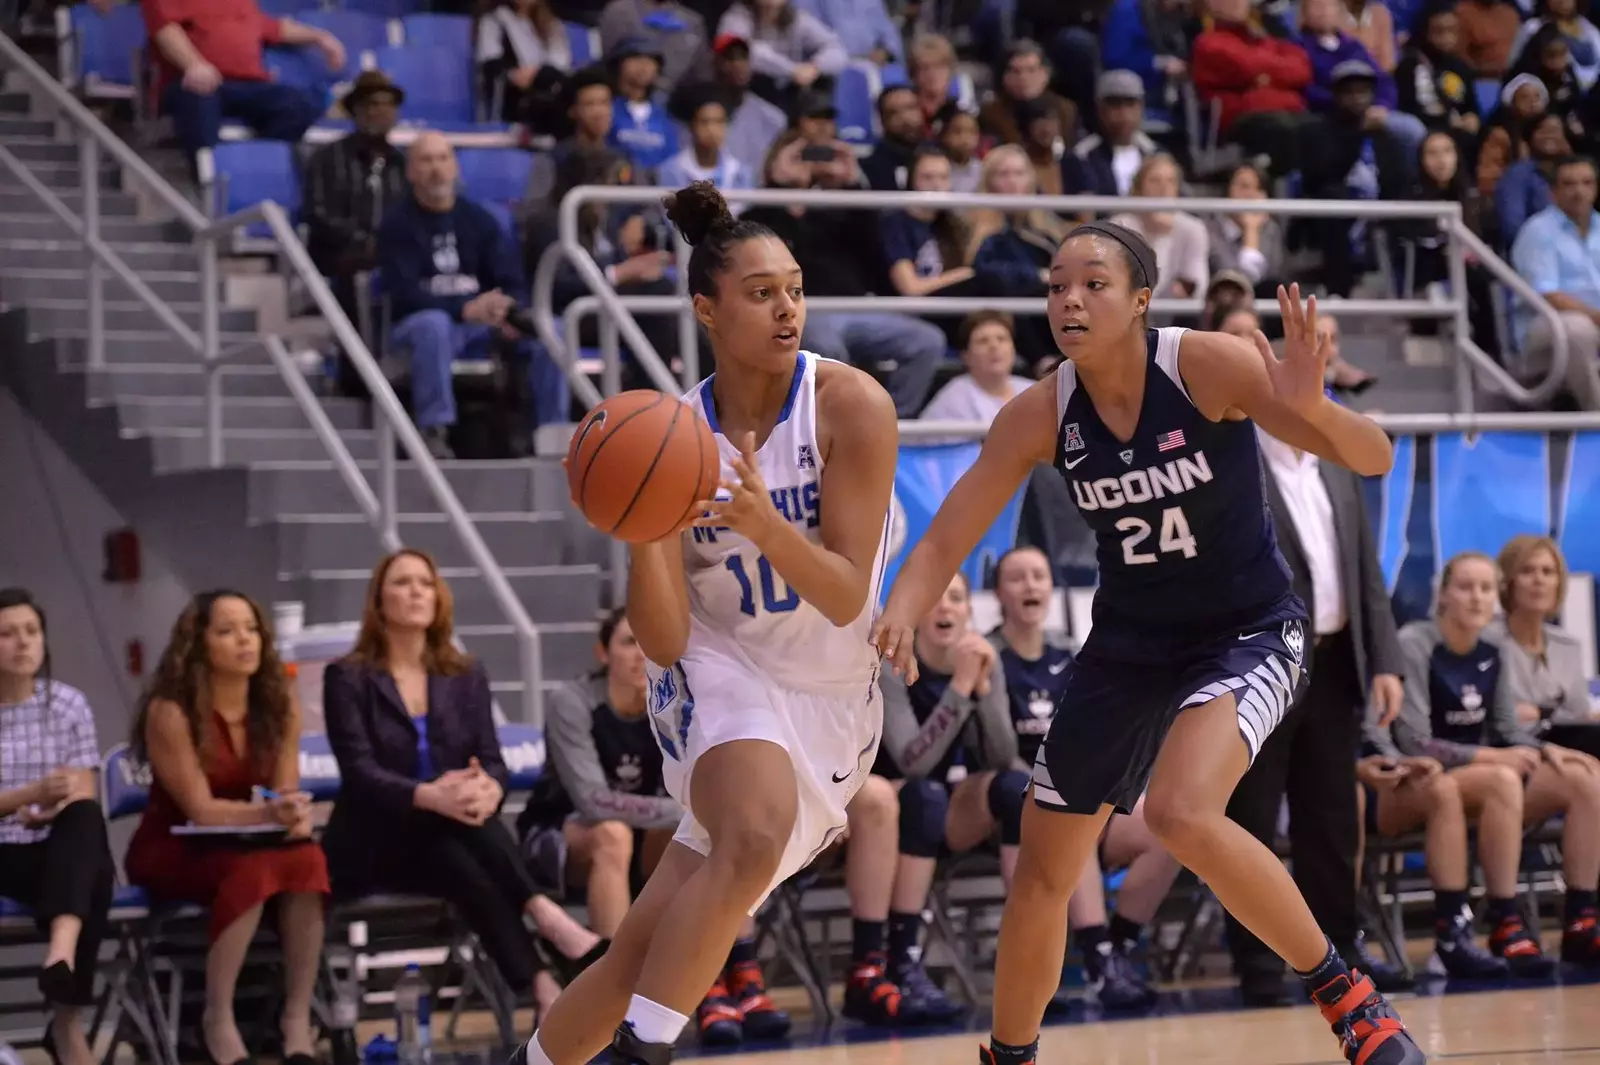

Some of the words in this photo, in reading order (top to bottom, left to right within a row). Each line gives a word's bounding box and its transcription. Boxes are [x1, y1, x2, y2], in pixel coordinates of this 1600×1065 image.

[1072, 450, 1214, 511] UCONN
[1114, 506, 1198, 565] 24
[724, 553, 801, 618] 10
